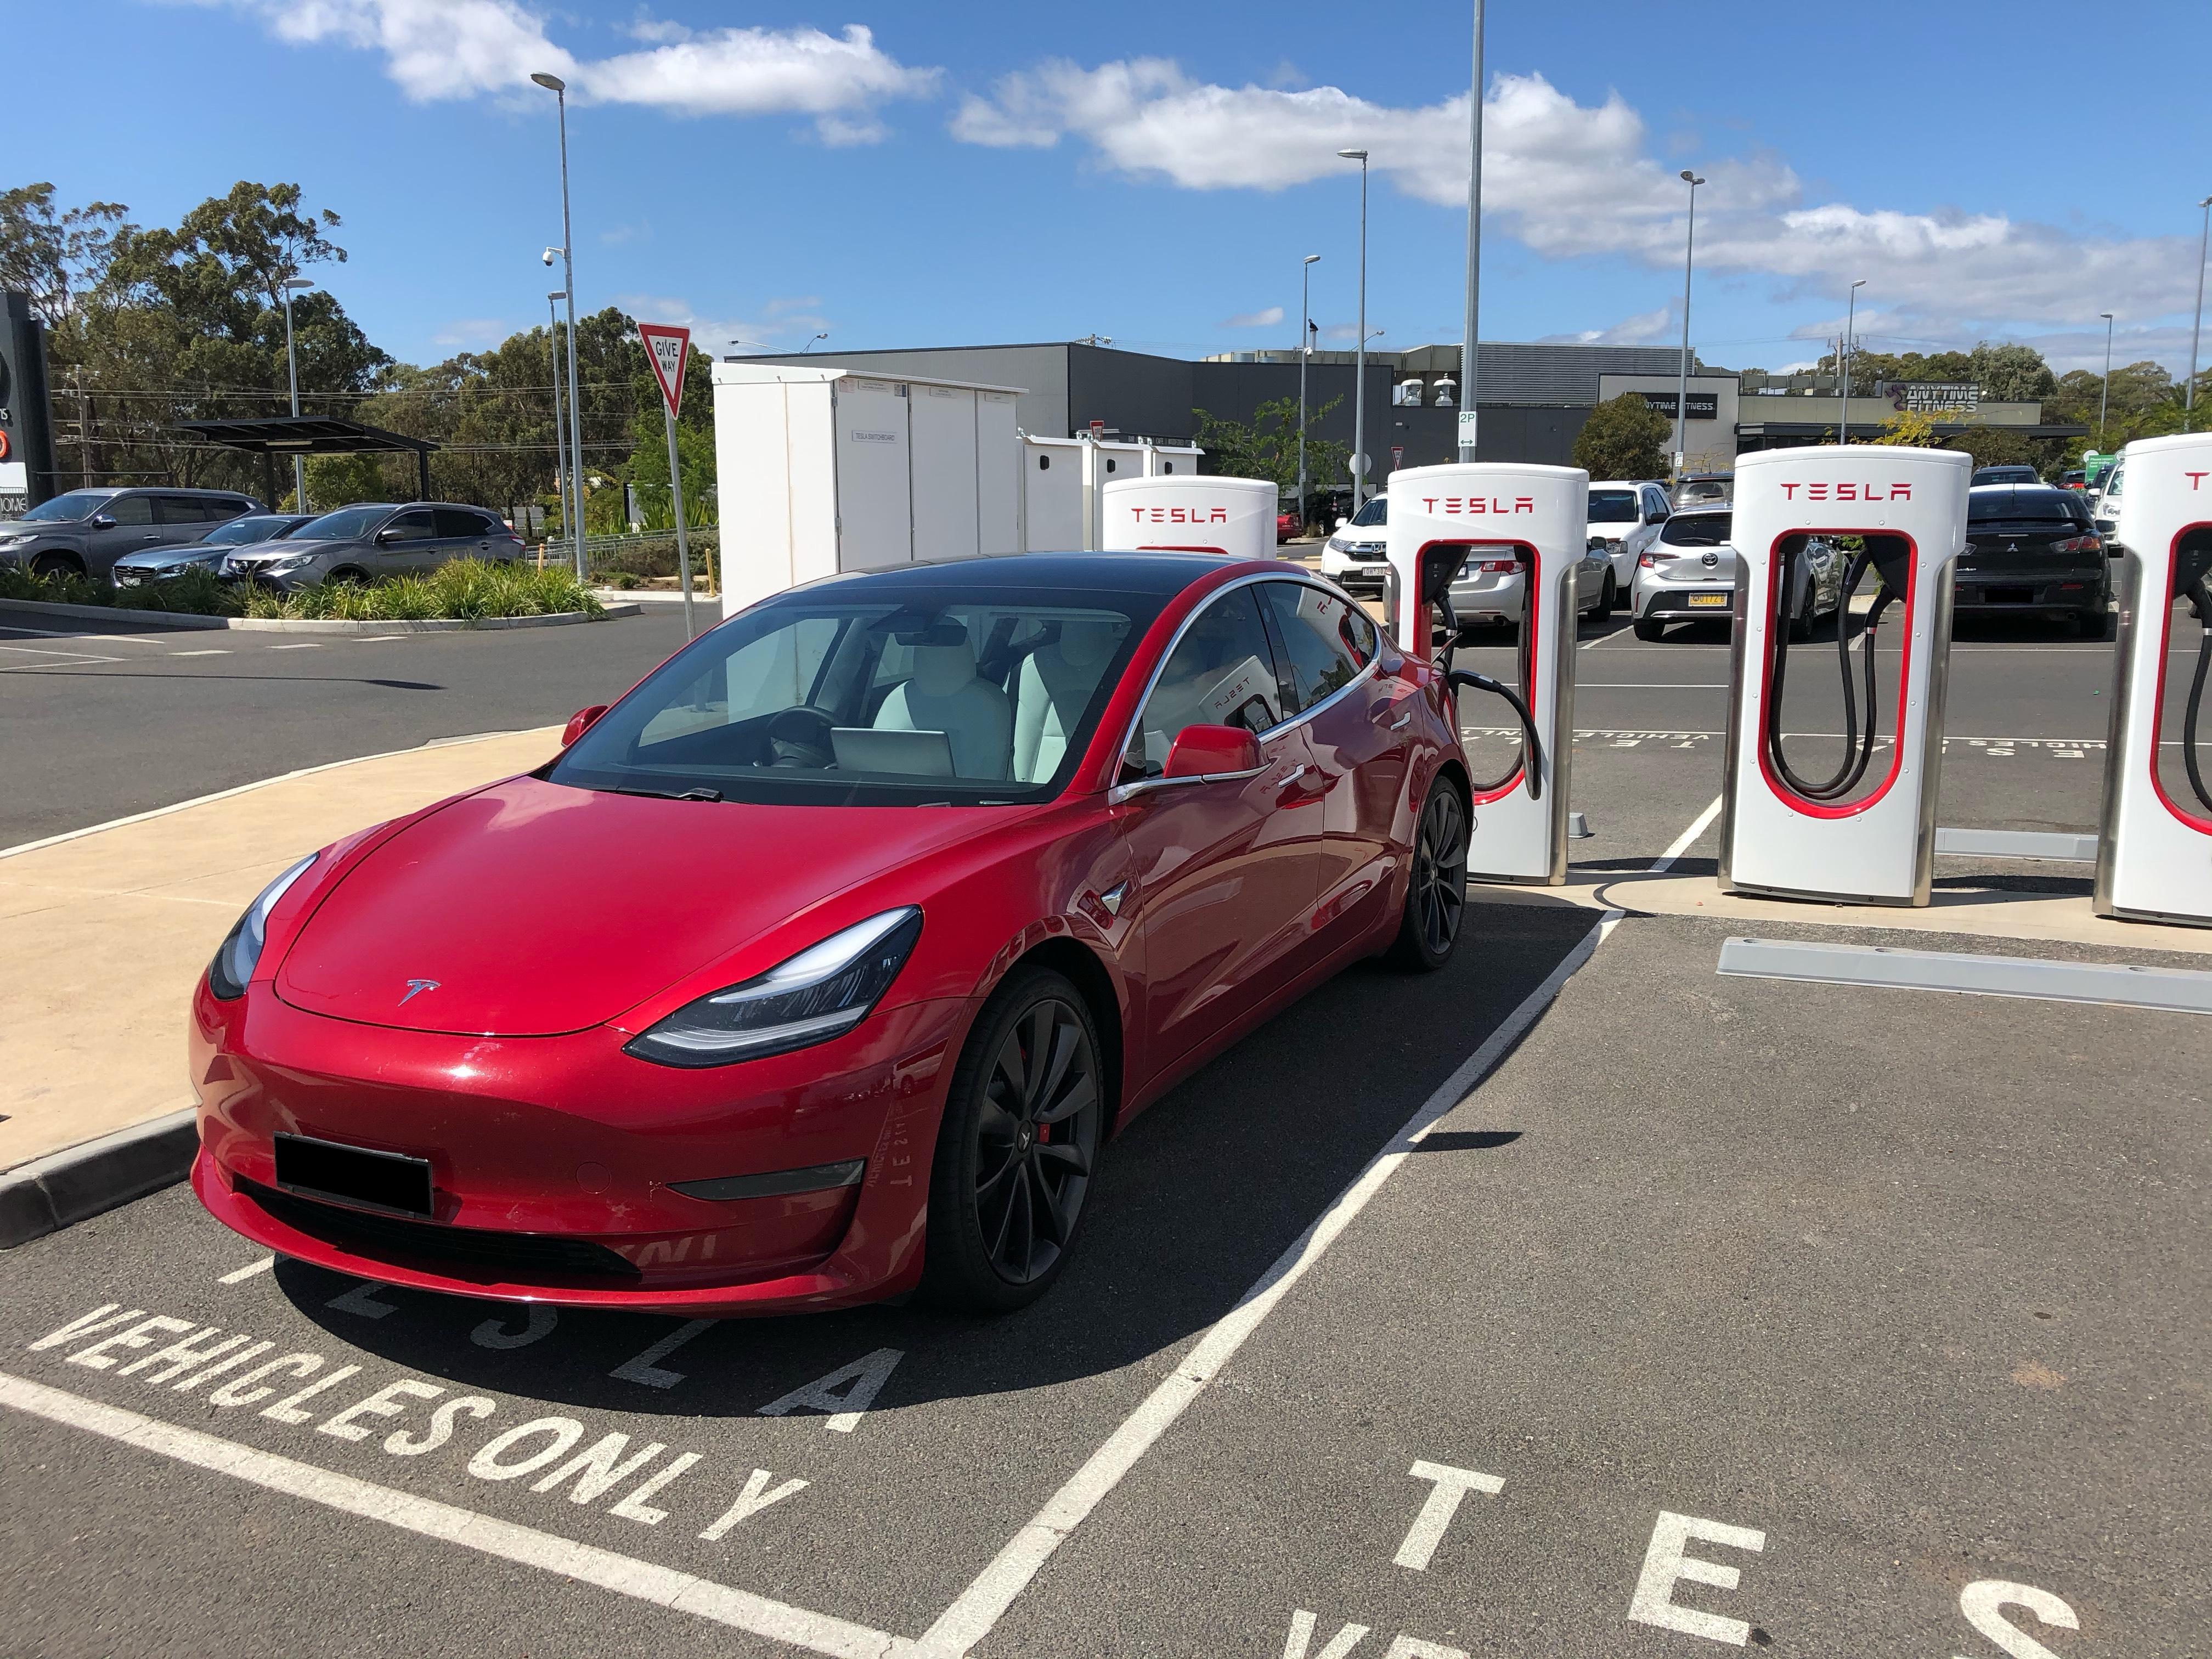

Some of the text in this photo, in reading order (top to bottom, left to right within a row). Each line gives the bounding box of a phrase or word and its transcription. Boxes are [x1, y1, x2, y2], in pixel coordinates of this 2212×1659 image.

[656, 339, 679, 357] GIVE
[661, 360, 675, 373] WAY
[1906, 385, 1979, 400] ANYTIME
[1906, 400, 1978, 413] FITNESS
[1460, 413, 1475, 423] 2P
[1780, 483, 1912, 501] TESLA
[1422, 497, 1533, 514] TESLA
[1131, 508, 1227, 523] TESLA
[27, 1304, 810, 1541] VEHICLES ONLY
